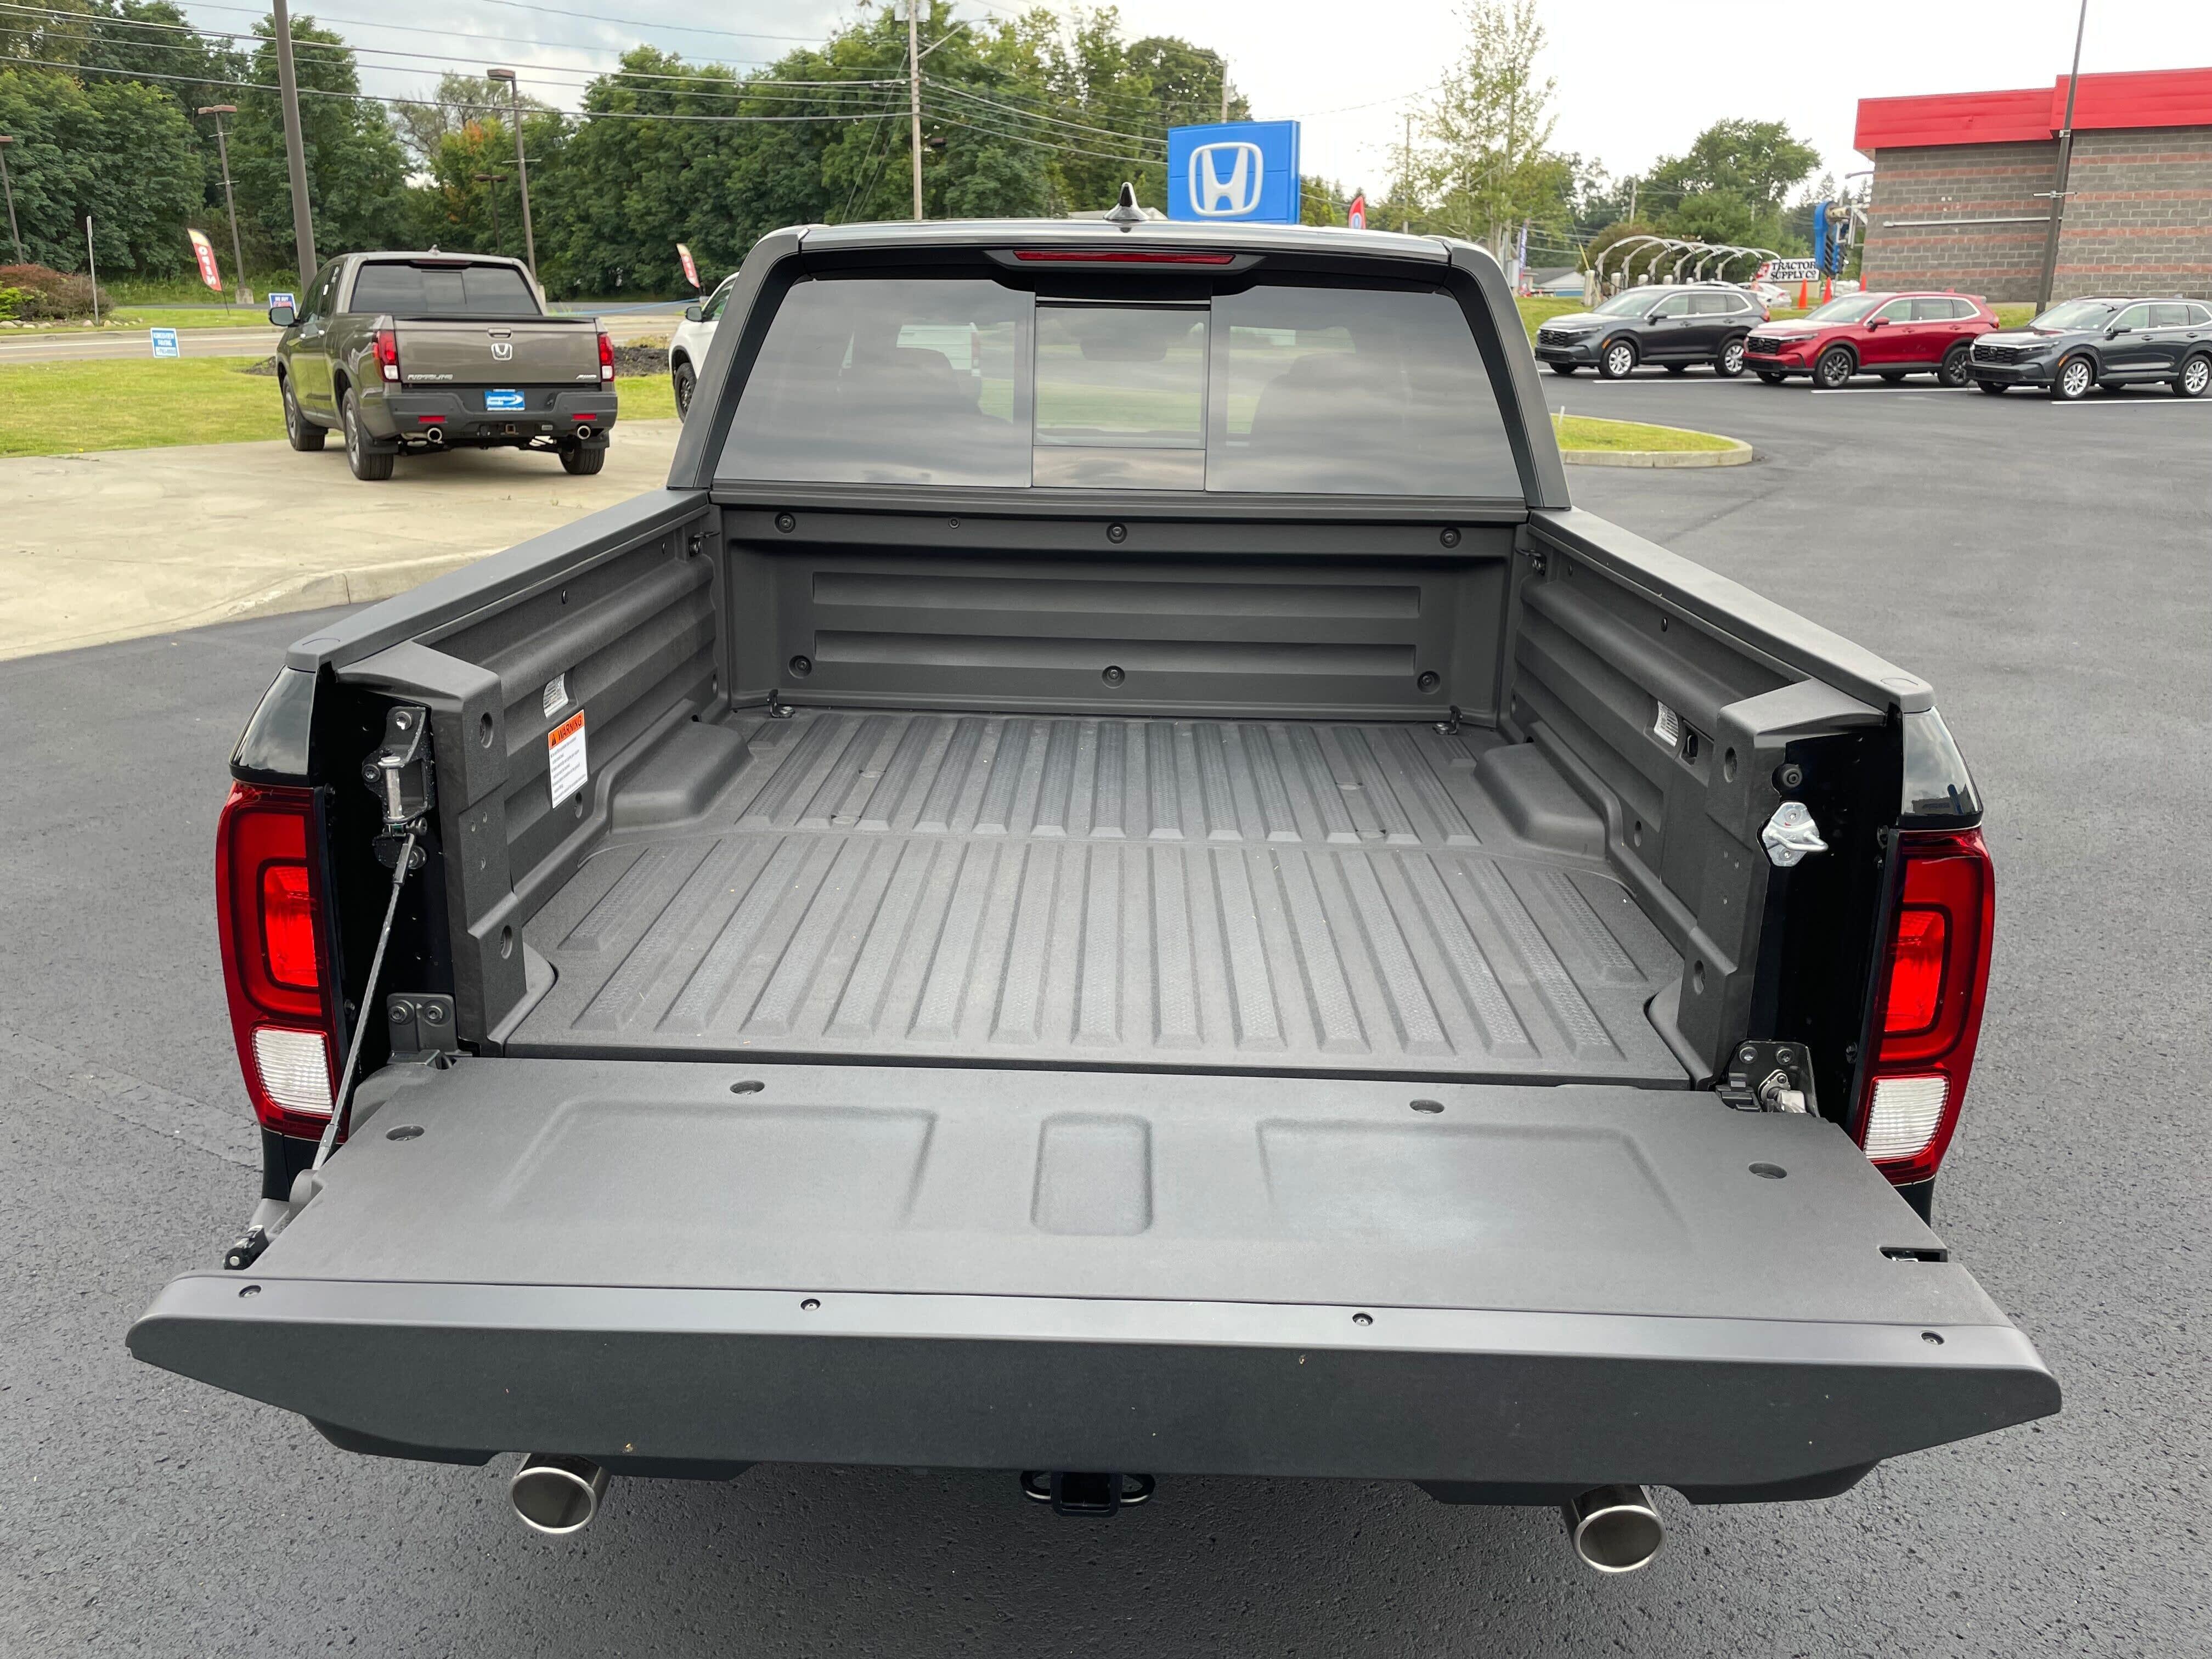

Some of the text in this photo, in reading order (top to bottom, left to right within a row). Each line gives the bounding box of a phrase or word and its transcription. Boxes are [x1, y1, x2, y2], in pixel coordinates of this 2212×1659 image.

[1772, 262, 1816, 270] TRACTOR
[1771, 271, 1804, 279] SUPPLY
[558, 715, 582, 741] WARNING
